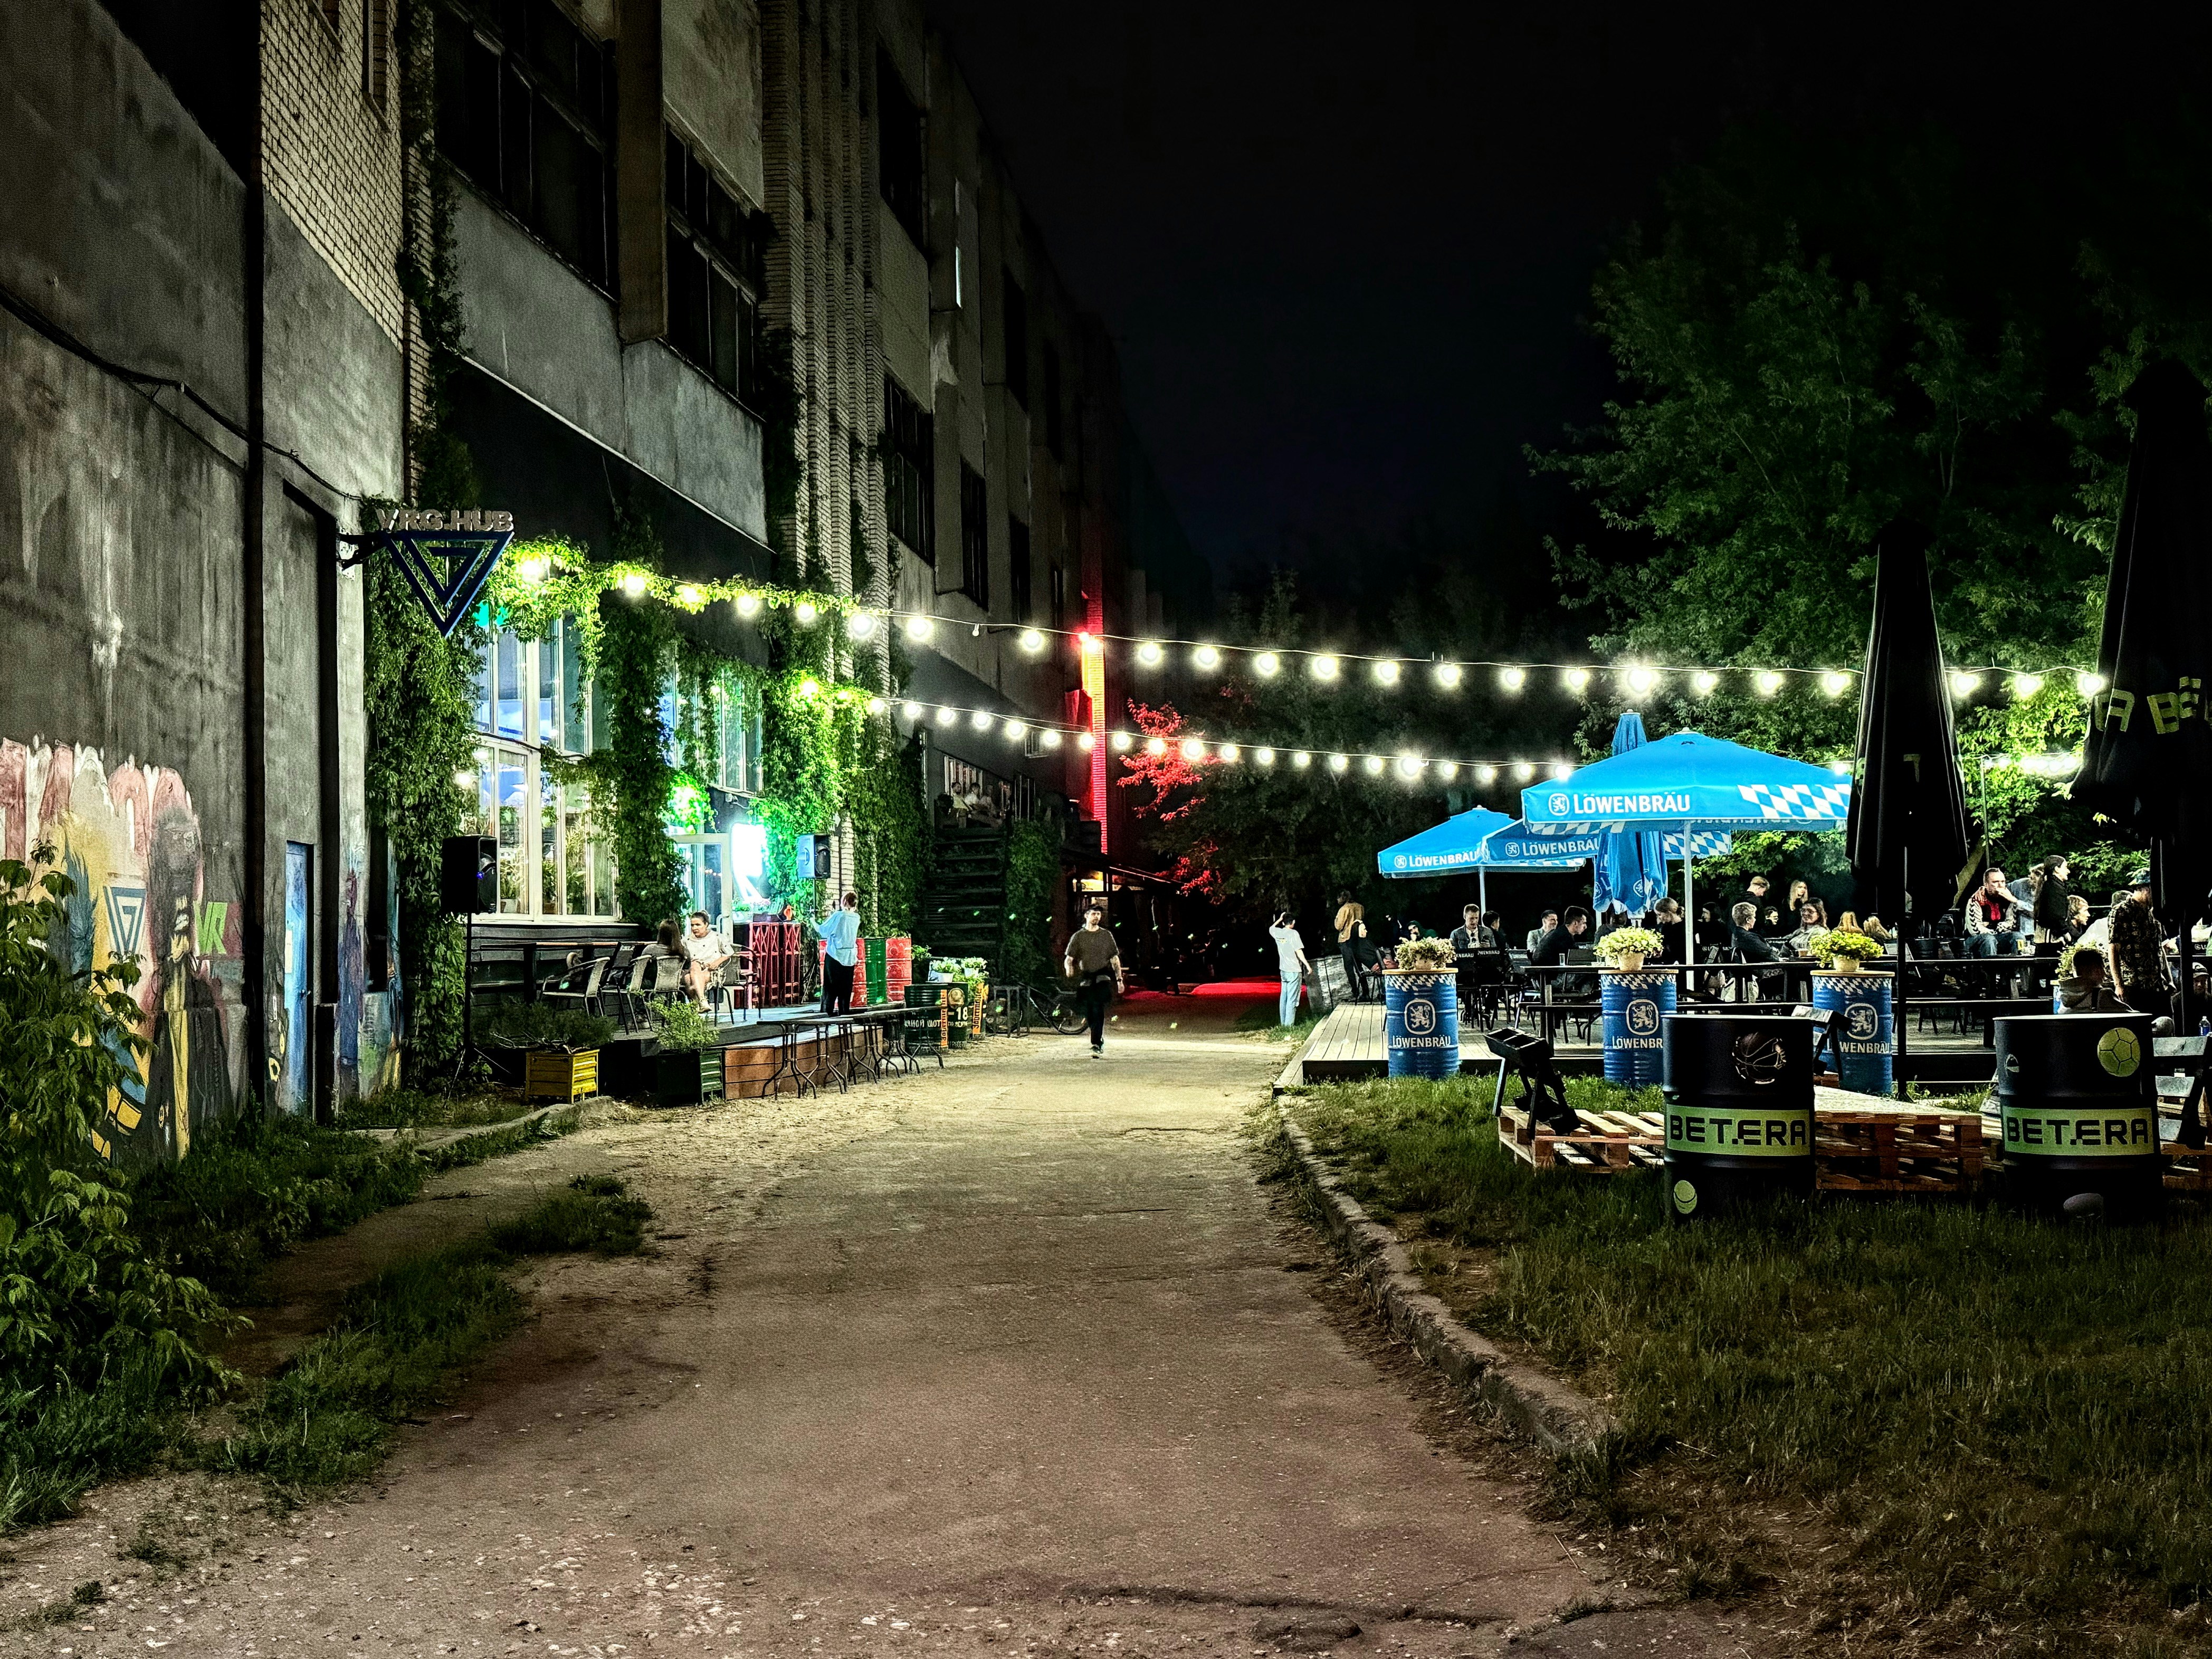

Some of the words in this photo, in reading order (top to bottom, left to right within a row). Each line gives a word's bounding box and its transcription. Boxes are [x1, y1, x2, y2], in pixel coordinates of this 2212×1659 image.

[1573, 791, 1690, 814] LÖWENBRÄU
[1522, 837, 1599, 856] LÖWENBRÄU
[1409, 850, 1477, 867] LÖWENBRÄU
[1392, 1035, 1451, 1048] LÖWENBRÄU
[1612, 1035, 1663, 1049] LÖWENBR
[1827, 1037, 1890, 1054] LWENBRÄU
[1670, 1114, 1806, 1146] BET.ERA
[2006, 1117, 2149, 1146] BET.ERA
